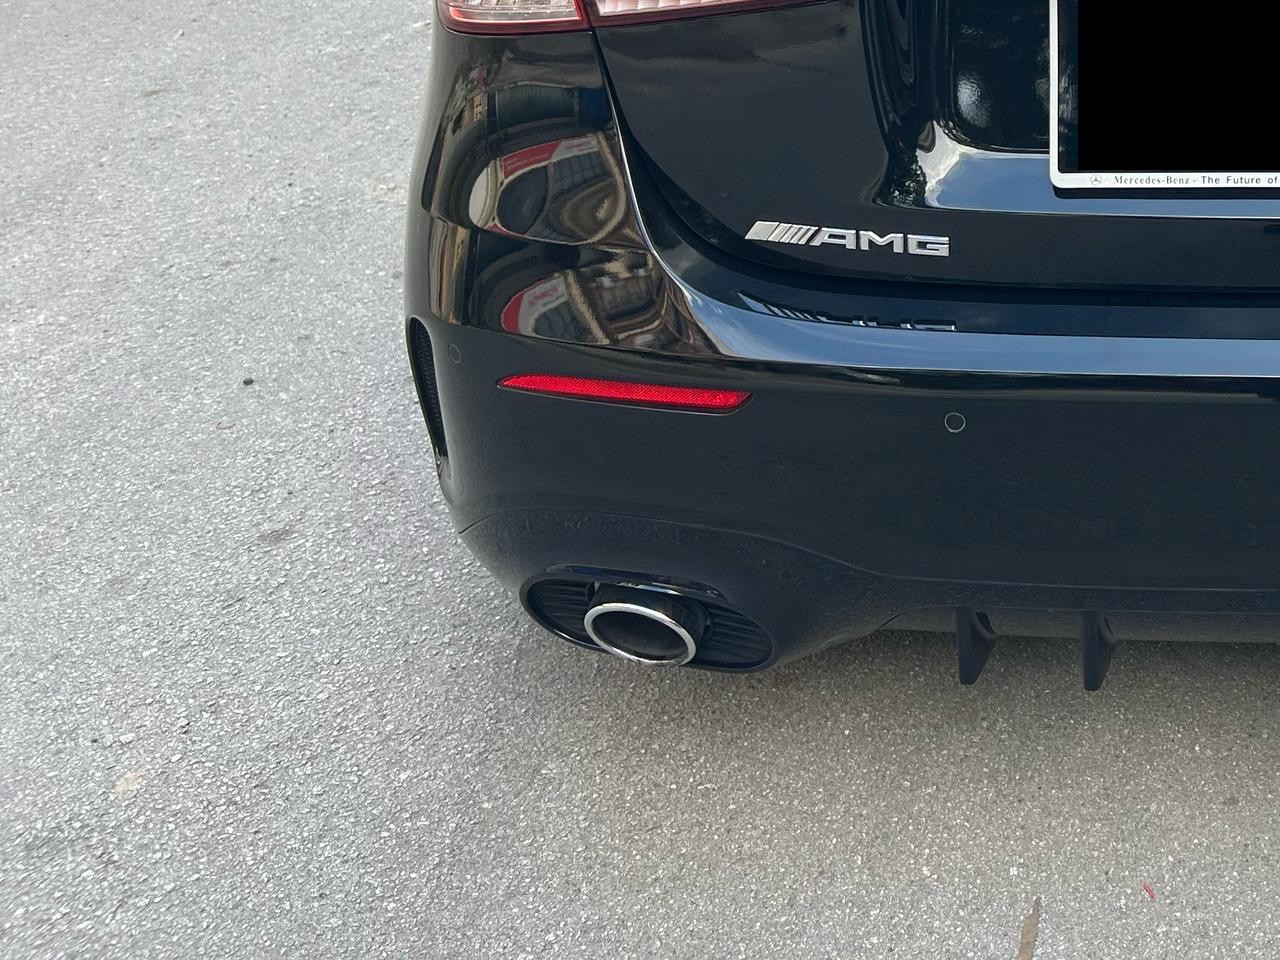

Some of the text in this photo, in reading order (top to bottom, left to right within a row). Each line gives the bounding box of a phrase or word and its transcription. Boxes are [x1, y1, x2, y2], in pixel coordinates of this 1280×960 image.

[1114, 175, 1190, 185] Mercedes-Benz
[1200, 175, 1221, 185] The
[1226, 175, 1261, 185] Future
[1267, 175, 1278, 185] of
[809, 227, 950, 257] AMG
